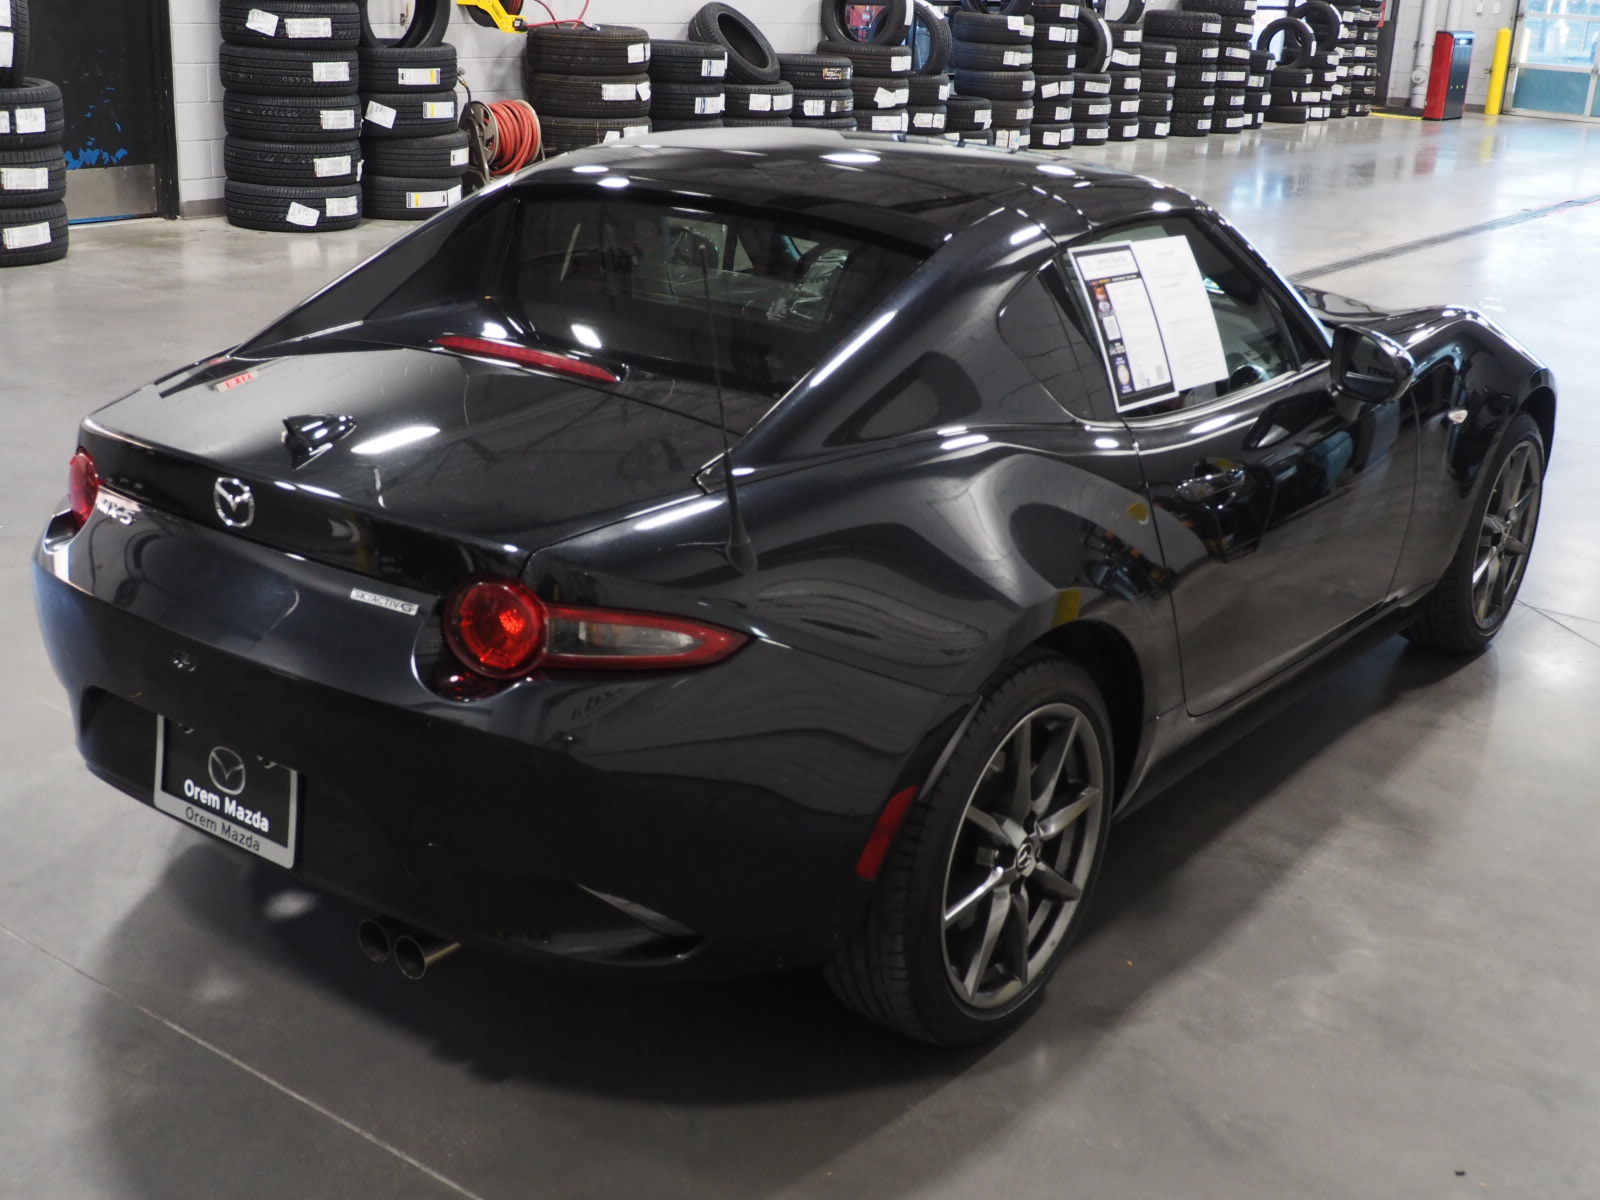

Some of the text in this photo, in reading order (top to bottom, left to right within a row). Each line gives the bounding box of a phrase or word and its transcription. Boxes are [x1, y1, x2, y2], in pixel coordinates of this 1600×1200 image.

[184, 779, 269, 832] Orem Mazda
[186, 806, 260, 851] Orem Mazda
